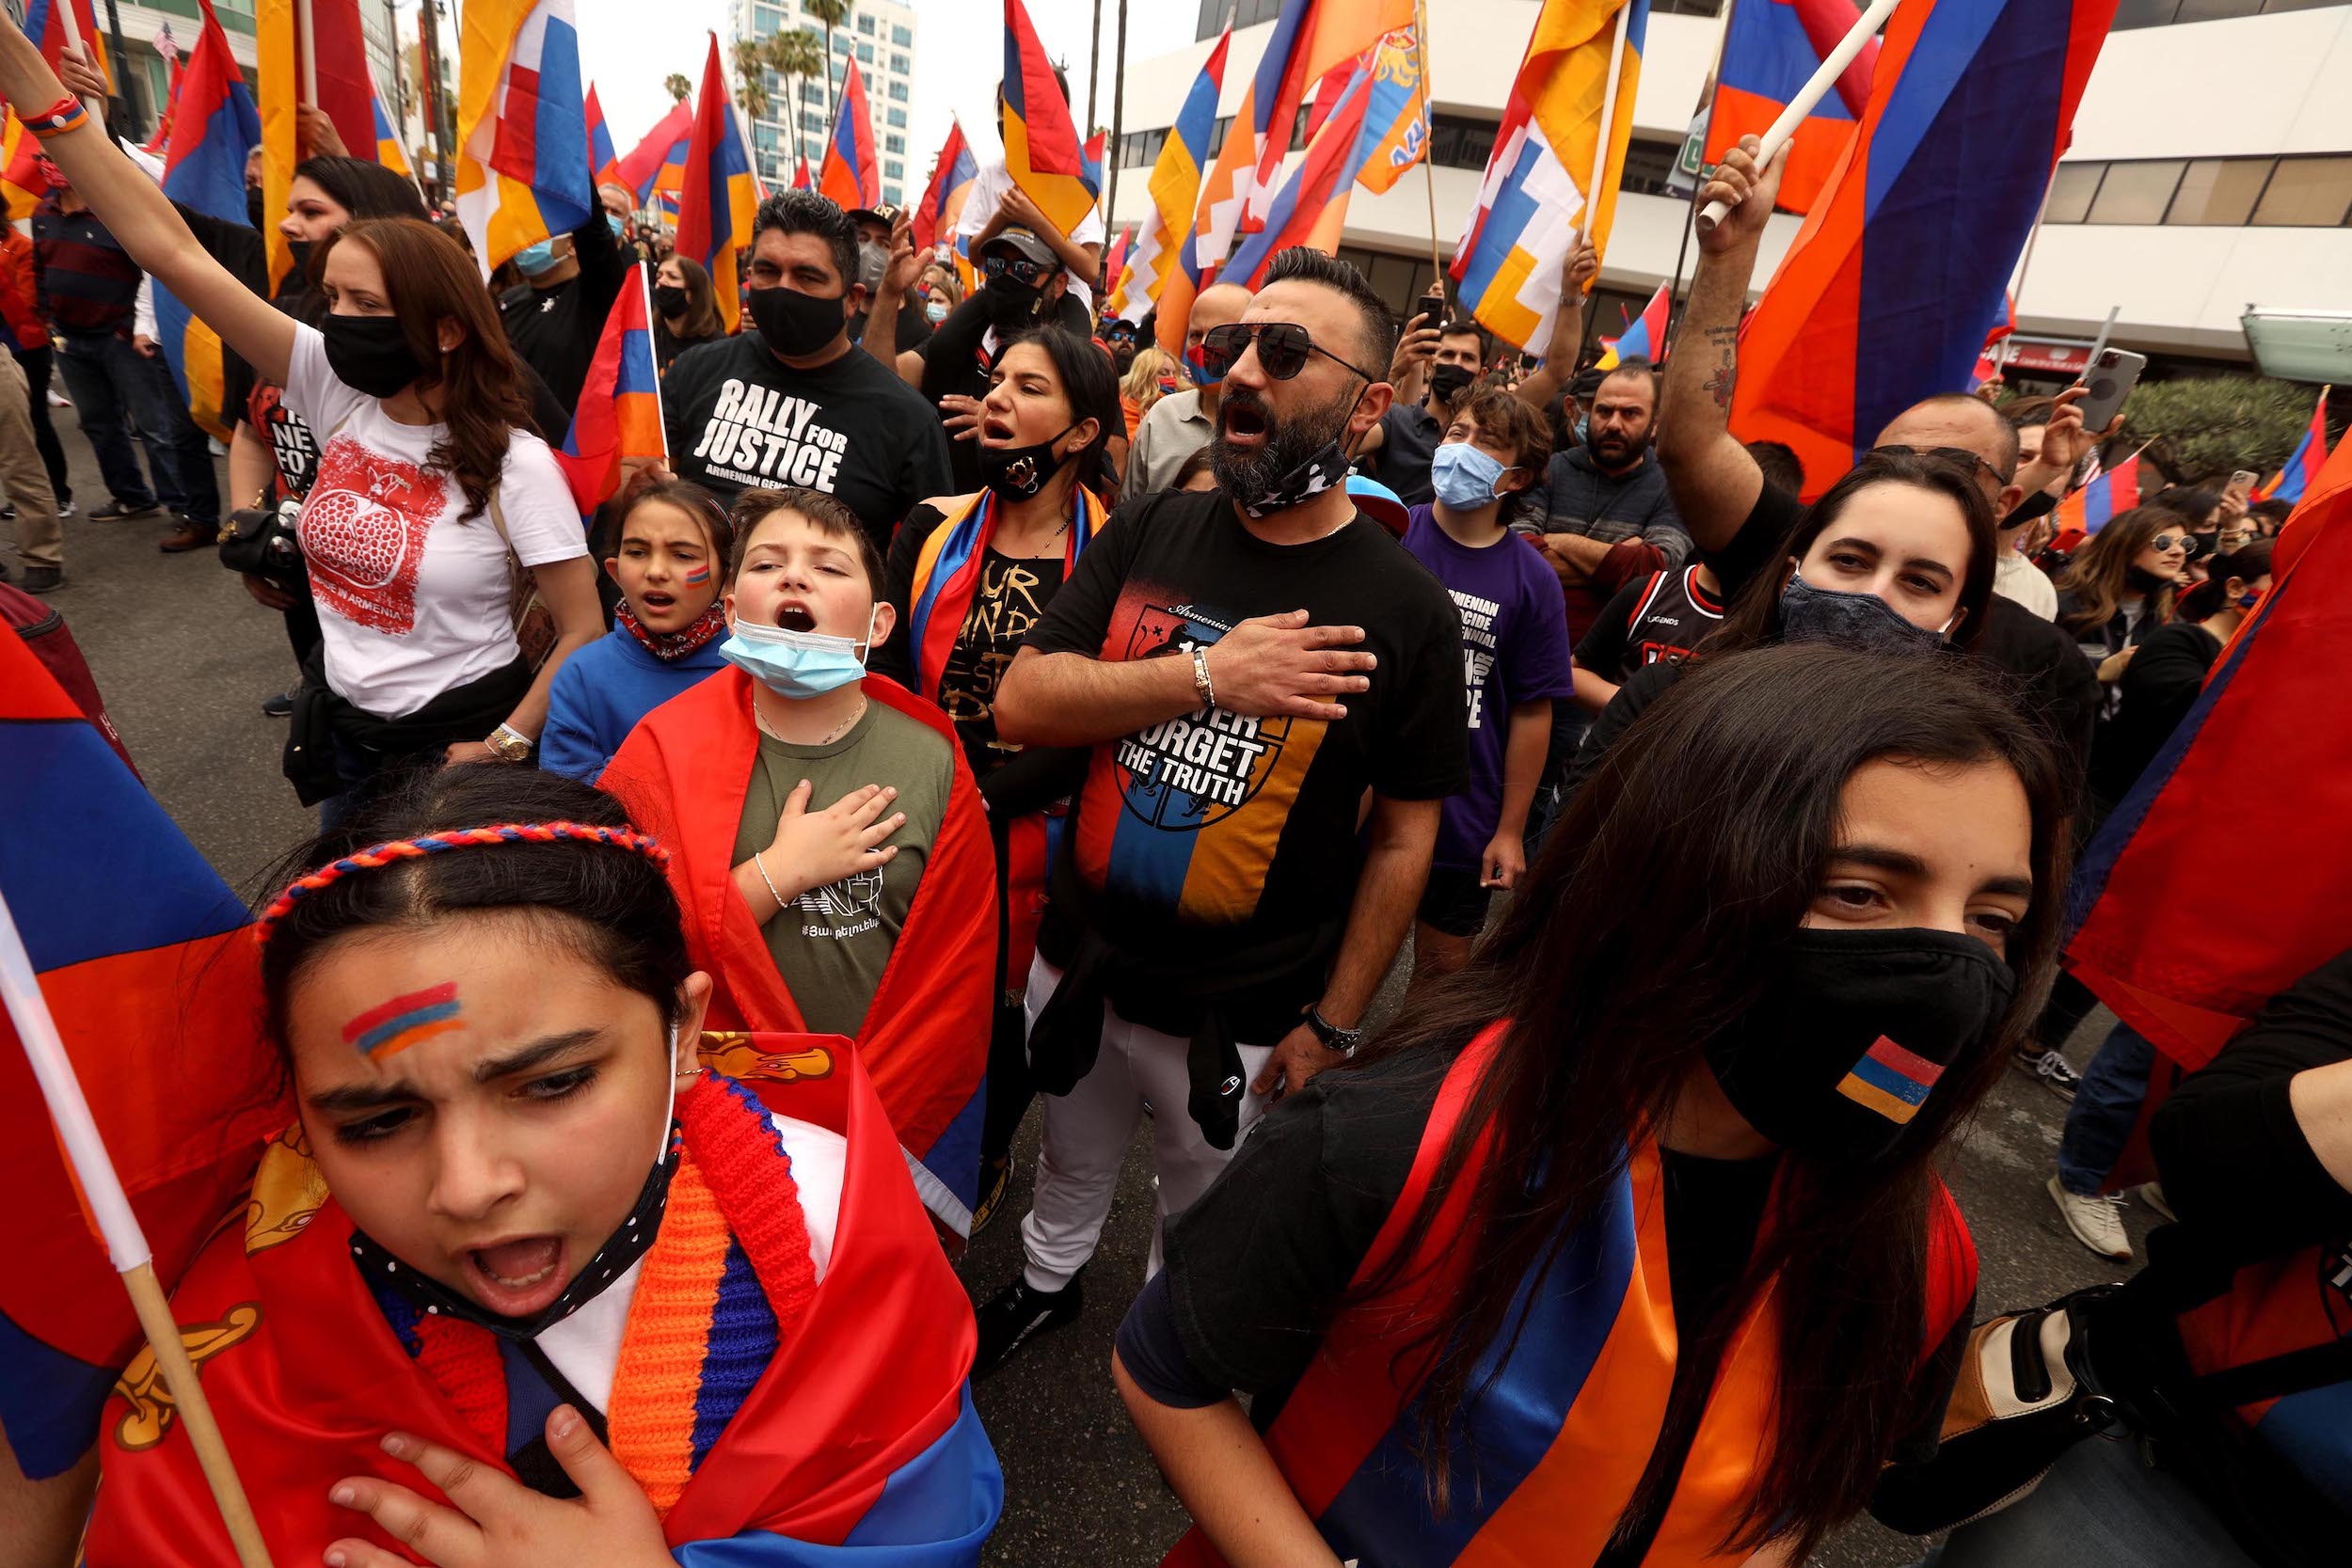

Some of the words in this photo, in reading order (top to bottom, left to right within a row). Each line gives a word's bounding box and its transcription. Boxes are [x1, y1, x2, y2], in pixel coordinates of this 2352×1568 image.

[712, 378, 819, 442] RALLY
[804, 423, 849, 453] FOR
[692, 418, 843, 494] JUSTICE
[705, 463, 761, 487] ARMENIAN
[337, 589, 348, 600] IN
[347, 593, 403, 622] ARMENIA
[1472, 651, 1496, 687] FOR
[1117, 737, 1157, 776] THE
[1160, 756, 1247, 806] TRUTH
[1138, 718, 1264, 779] ORGET
